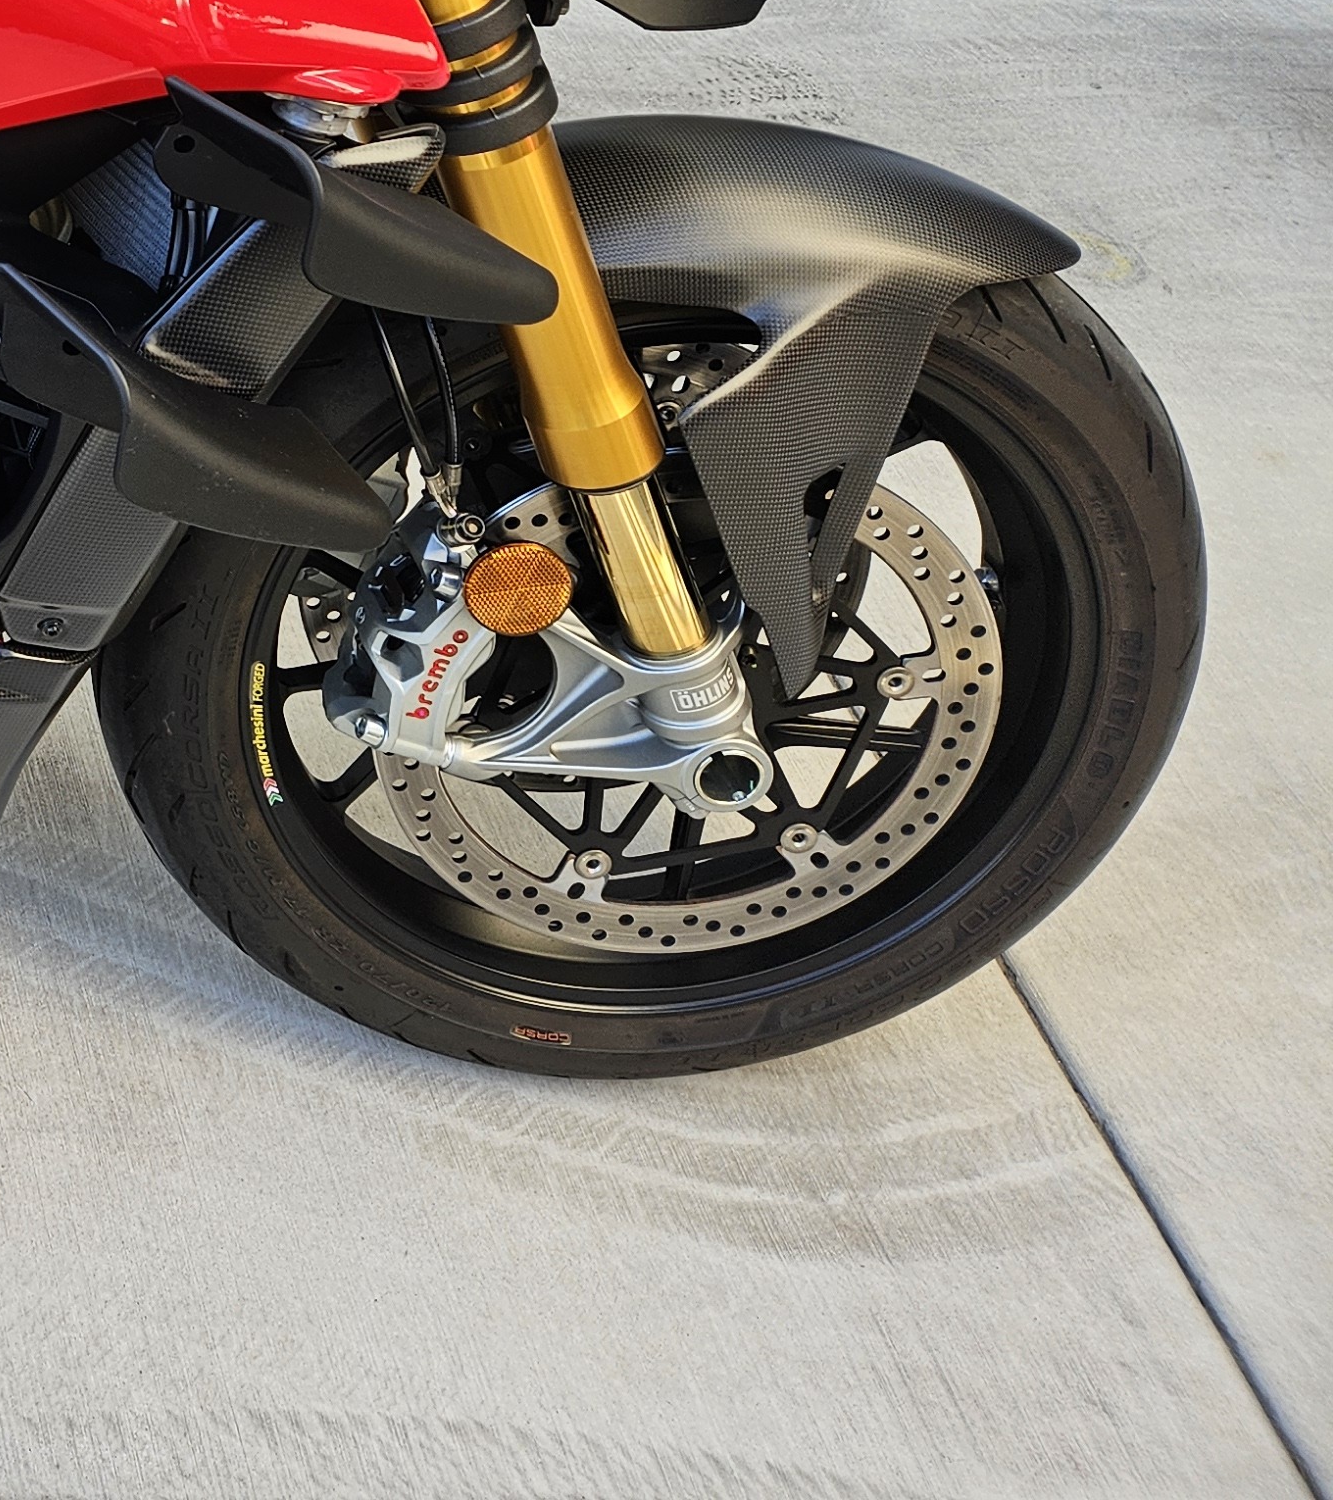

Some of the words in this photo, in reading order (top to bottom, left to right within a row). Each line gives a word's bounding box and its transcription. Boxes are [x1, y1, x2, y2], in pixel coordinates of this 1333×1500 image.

[252, 663, 265, 702] FORGED
[405, 629, 469, 720] brembo
[677, 666, 734, 710] ÖHLINS
[186, 645, 207, 790] CORSA
[249, 704, 274, 778] marchesini
[957, 827, 1073, 936] ROSSO
[311, 926, 347, 955] ZR
[358, 961, 453, 1012] 120/70
[511, 1025, 571, 1045] CORSA
